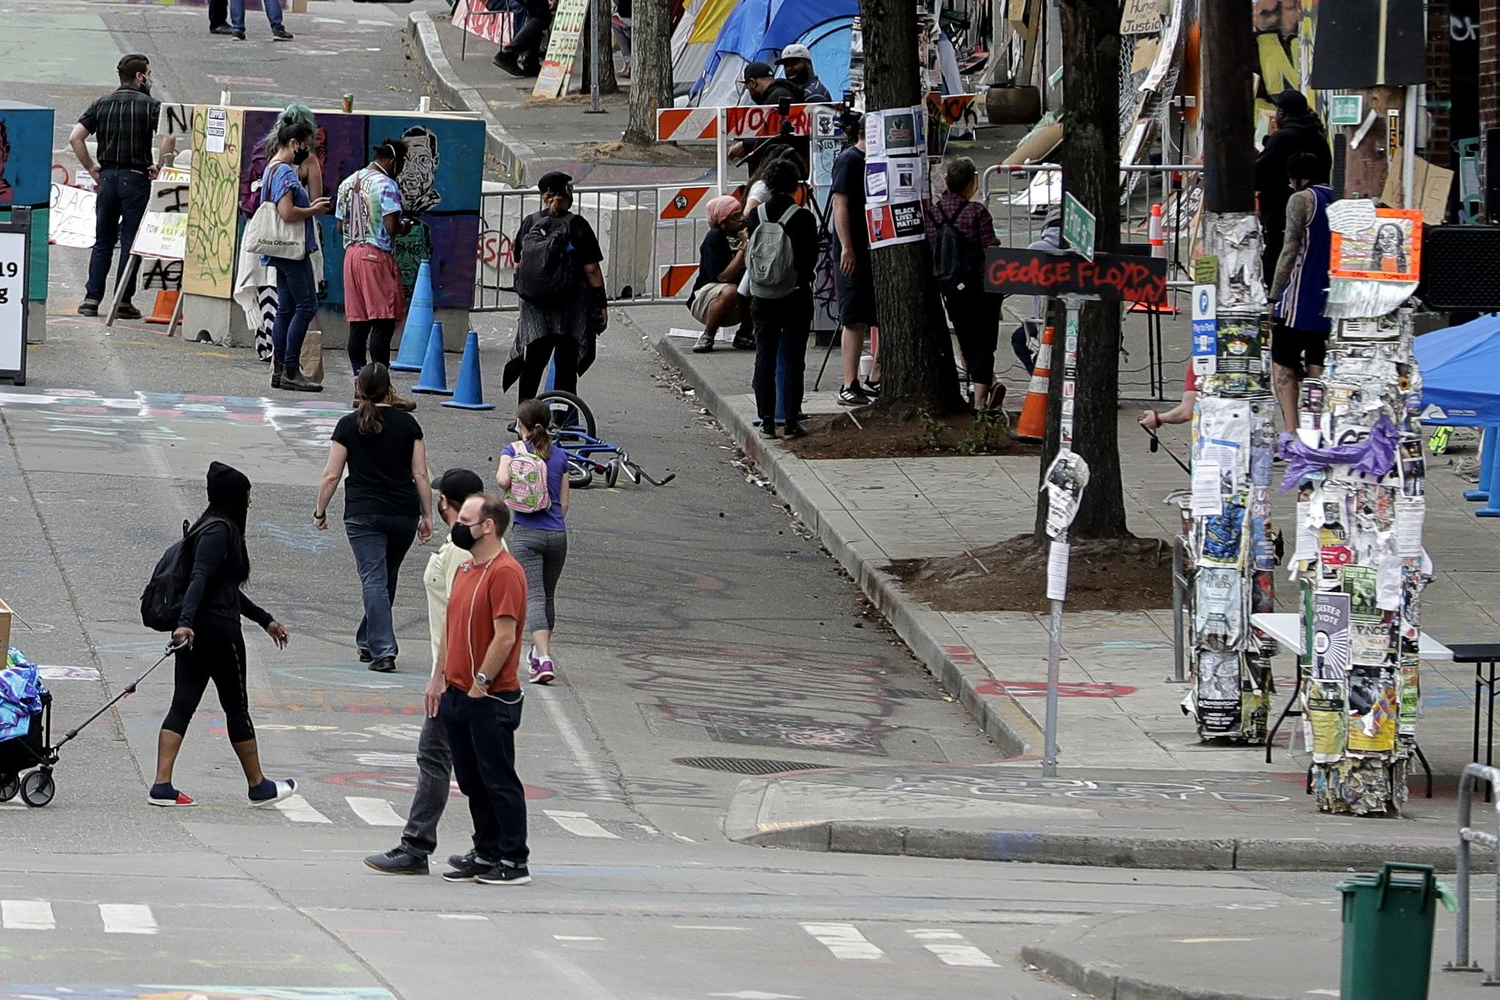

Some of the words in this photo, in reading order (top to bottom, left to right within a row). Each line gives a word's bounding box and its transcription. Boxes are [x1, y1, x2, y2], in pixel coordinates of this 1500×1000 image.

[1130, 0, 1156, 14] Hung
[50, 184, 96, 212] BLAC
[894, 206, 915, 216] BLACK
[895, 213, 913, 222] LIVES
[896, 219, 920, 228] MATTER
[257, 238, 273, 247] Atlas
[274, 239, 300, 247] Obscura
[989, 257, 1072, 287] GEORGE
[1077, 261, 1150, 290] FLOYD
[1122, 274, 1167, 303] WAY
[1315, 604, 1341, 617] GISTER
[1319, 614, 1339, 627] VOTE
